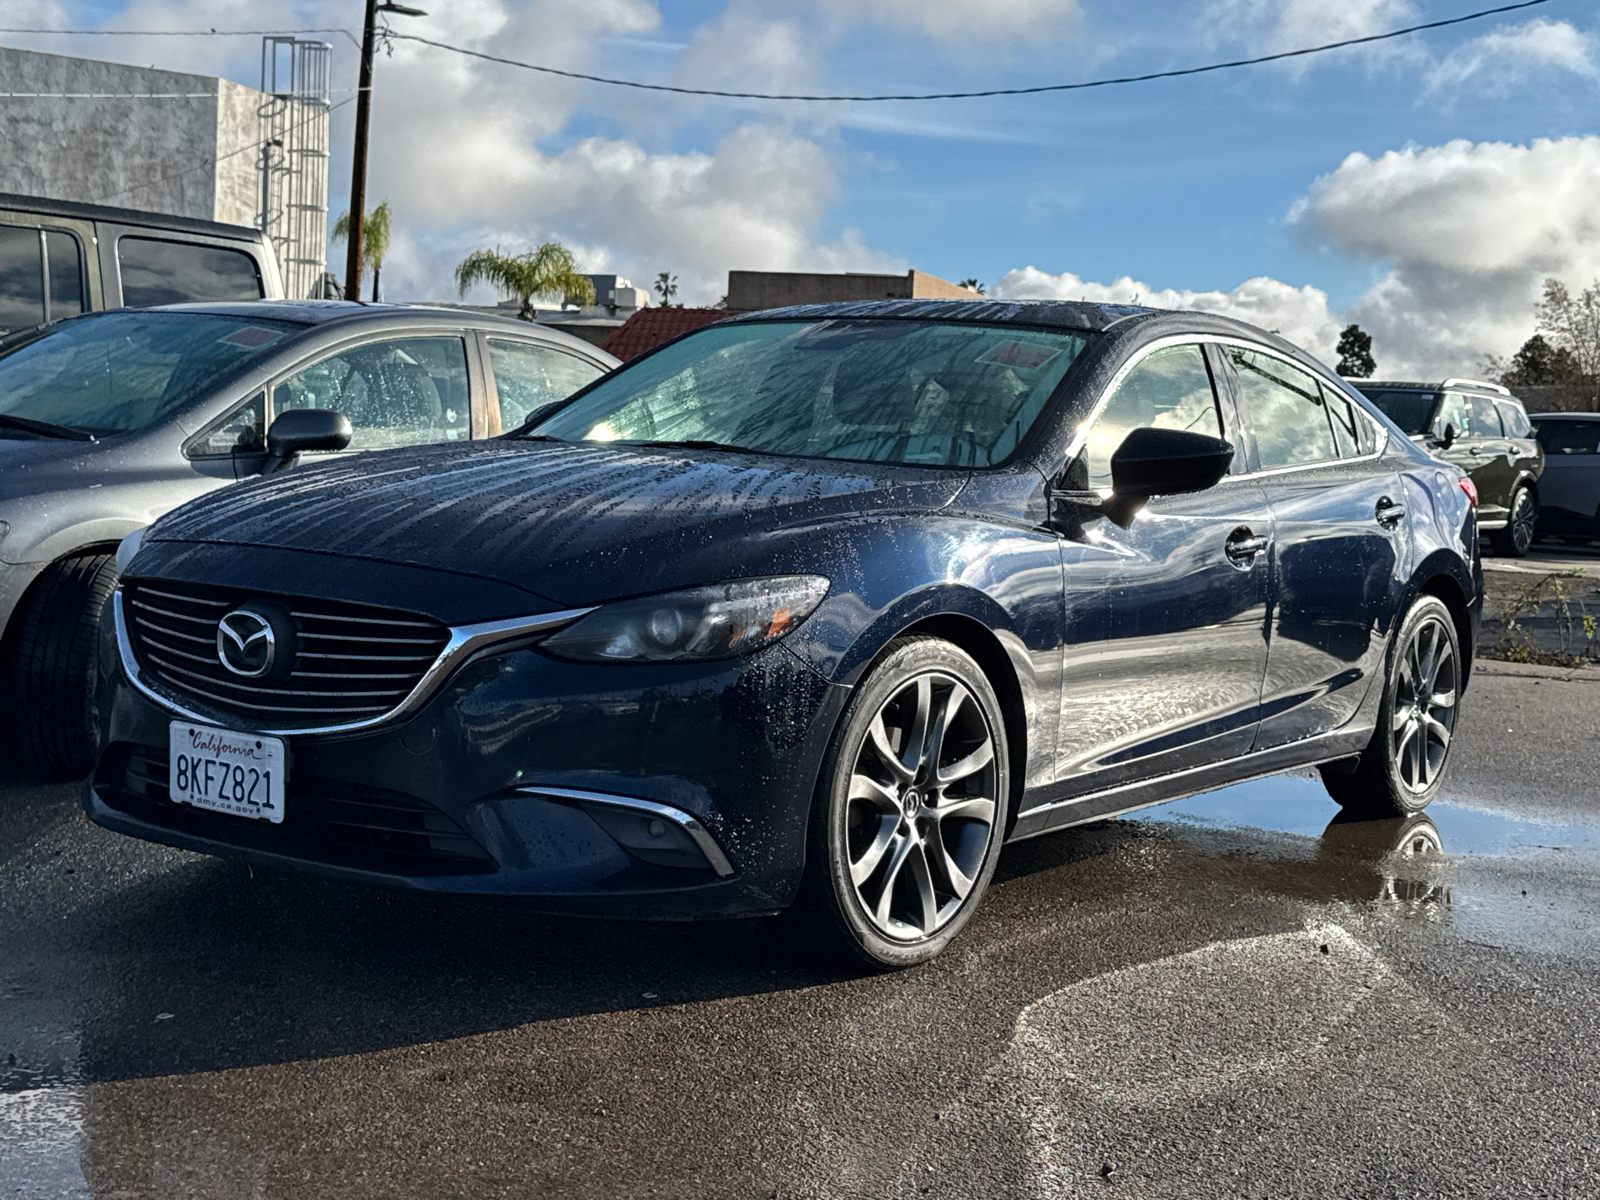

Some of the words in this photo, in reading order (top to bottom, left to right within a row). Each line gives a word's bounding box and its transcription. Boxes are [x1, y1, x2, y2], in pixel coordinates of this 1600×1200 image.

[193, 731, 262, 760] California
[177, 754, 275, 810] 8KFZ821
[197, 797, 254, 813] dmv.ca.gov
